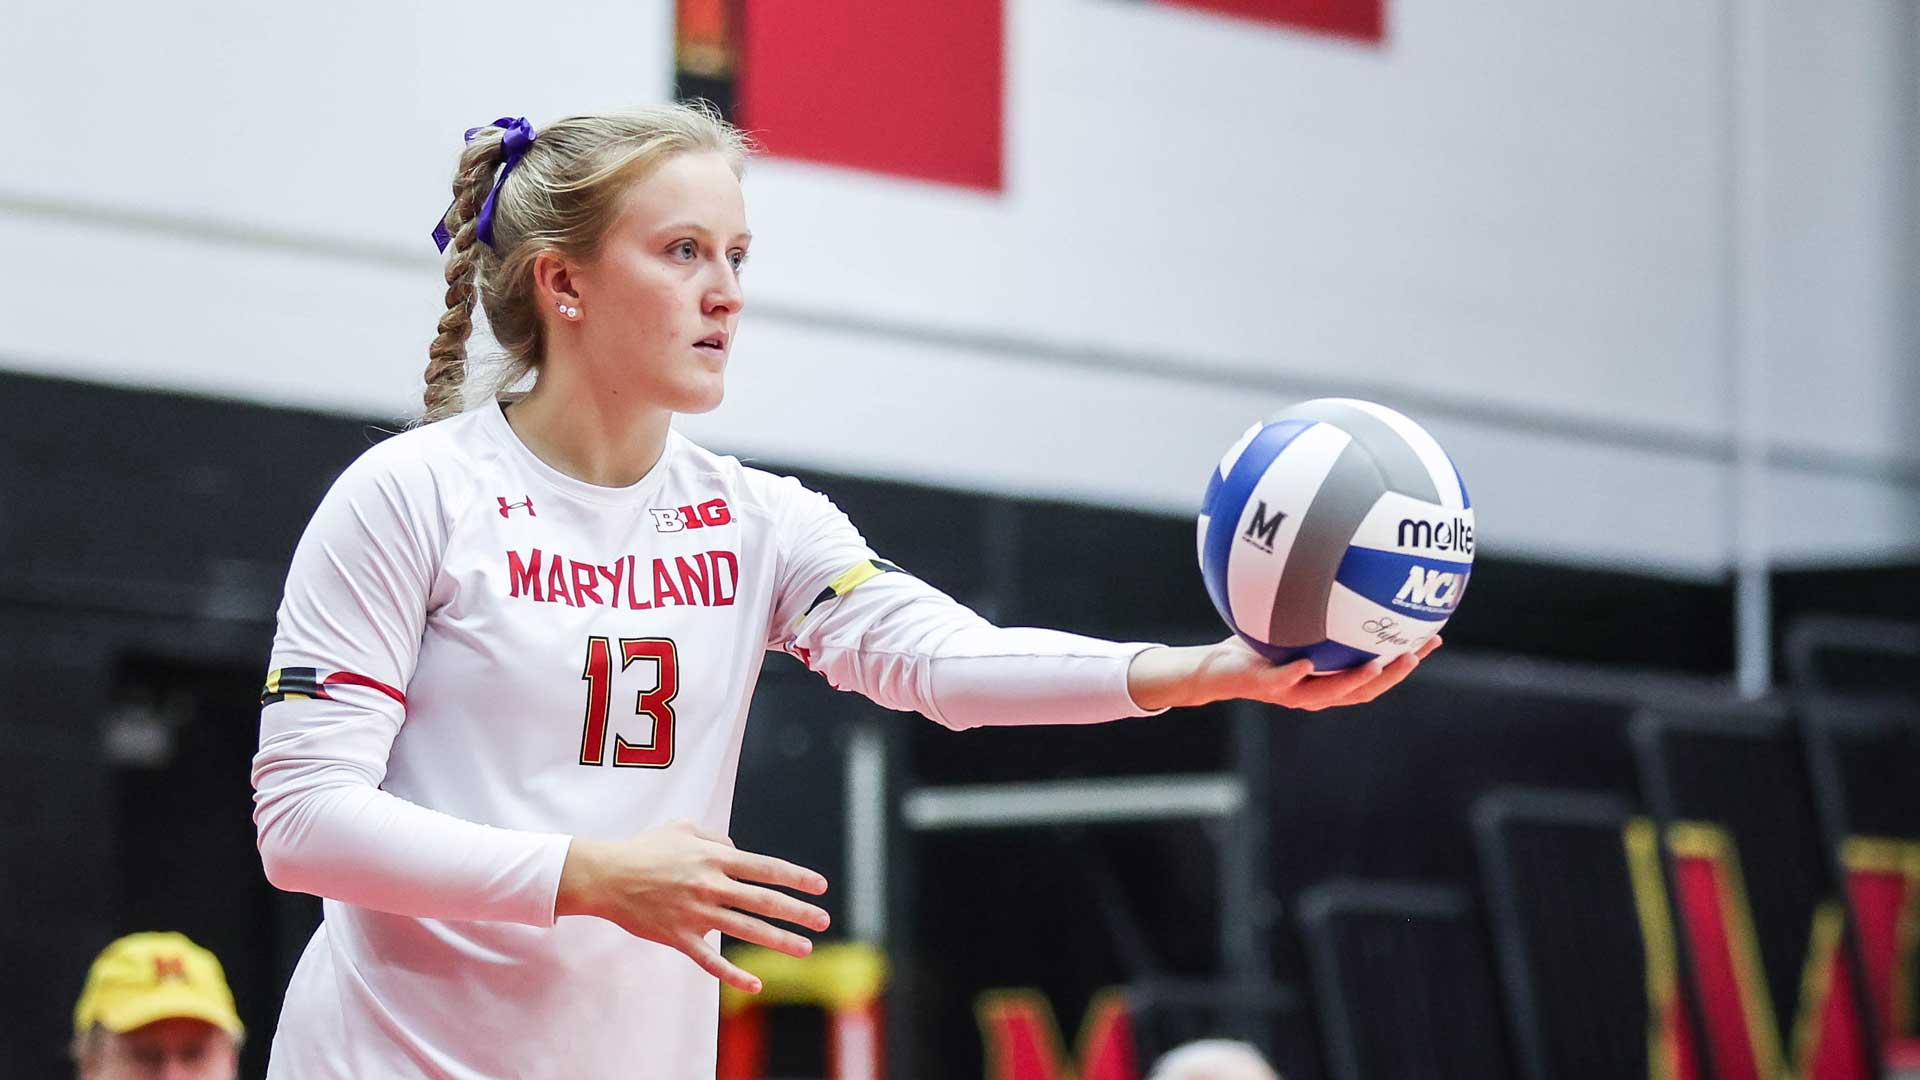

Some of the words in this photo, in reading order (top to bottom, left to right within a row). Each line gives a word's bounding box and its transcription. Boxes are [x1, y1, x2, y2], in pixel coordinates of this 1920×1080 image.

[1245, 499, 1288, 549] M
[506, 548, 739, 610] MARYLAND
[579, 636, 680, 769] 13
